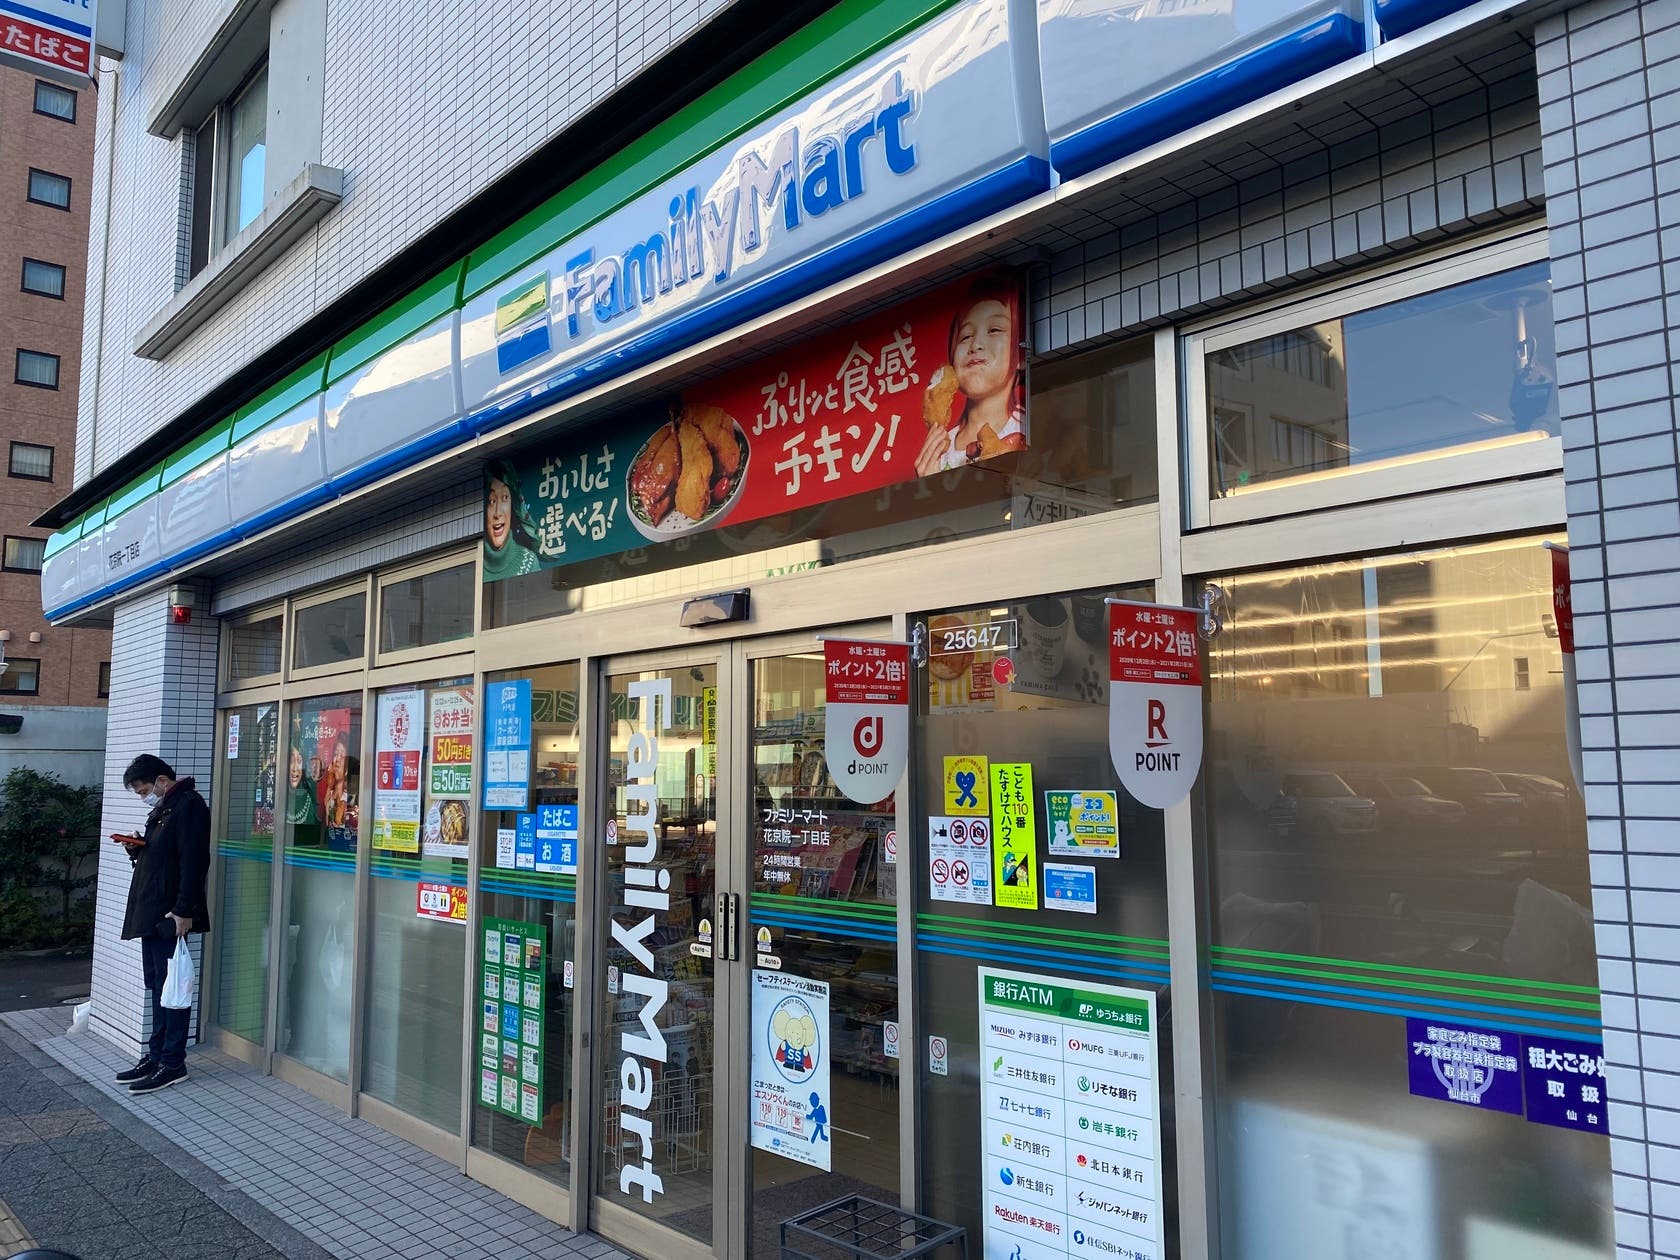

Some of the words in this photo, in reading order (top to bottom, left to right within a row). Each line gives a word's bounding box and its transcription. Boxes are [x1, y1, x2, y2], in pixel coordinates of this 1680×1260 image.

[5, 25, 84, 67] たばこ
[563, 71, 919, 339] FamilyMart
[538, 443, 617, 501] おいしさ
[538, 498, 619, 557] 選べる!
[943, 626, 1002, 651] 25647
[1113, 627, 1197, 657] ポイント2倍!
[828, 659, 906, 682] ポイント2倍!
[1148, 699, 1169, 740] R
[847, 760, 856, 775] d
[858, 763, 889, 775] POINT
[1135, 752, 1181, 772] POINT
[1012, 765, 1029, 829] こども110番
[1051, 796, 1068, 804] eco
[1085, 798, 1103, 810] エコ
[543, 808, 572, 827] たばこ
[763, 808, 828, 826] ファミリーマート
[998, 769, 1013, 848] たすけてハウス
[763, 829, 831, 847] 花京院一丁目店
[541, 842, 572, 863] お酒
[763, 854, 802, 869] 24時間営業
[763, 871, 792, 883] 年中無休
[611, 677, 672, 1204] FamilyMart
[993, 981, 1053, 1006] 銀行ATM
[1096, 1009, 1143, 1026] ゆうちょ銀行
[990, 1024, 1015, 1036] MIZUHO
[1018, 1027, 1057, 1047] みずほ銀行
[1426, 1026, 1502, 1051] 家庭ごみ指定袋
[787, 1048, 802, 1062] SS
[1082, 1043, 1104, 1054] MUFG
[1413, 1041, 1518, 1072] プラ製容器包装指定袋
[1007, 1066, 1056, 1086] 三井住友銀行
[1443, 1063, 1485, 1084] 取扱店
[1092, 1081, 1137, 1102] りそな銀行
[1448, 1088, 1481, 1104] 仙台市
[1547, 1080, 1600, 1104] 取扱
[1010, 1102, 1051, 1119] 七十七銀行
[1092, 1119, 1138, 1142] 岩手銀行
[1014, 1137, 1050, 1158] 荘内銀行
[1090, 1159, 1144, 1183] 北日本銀行
[1016, 1175, 1054, 1197] 新生銀行
[995, 1205, 1029, 1224] Rakuten
[1029, 1216, 1061, 1236] 楽天銀行
[1088, 1196, 1148, 1224] ジャパンネット銀行
